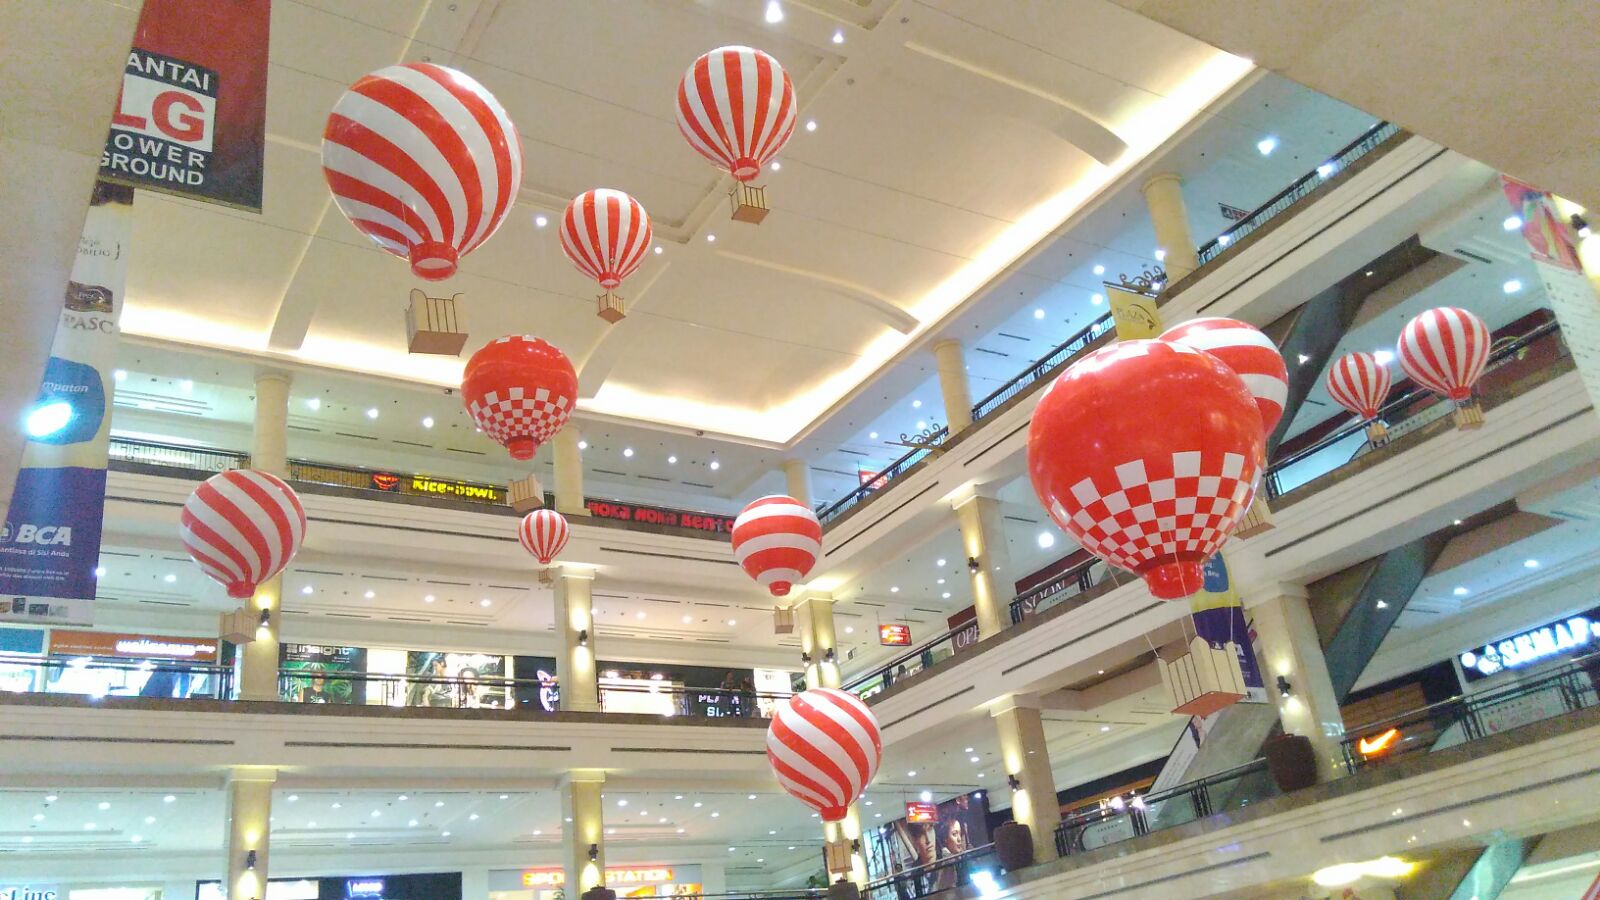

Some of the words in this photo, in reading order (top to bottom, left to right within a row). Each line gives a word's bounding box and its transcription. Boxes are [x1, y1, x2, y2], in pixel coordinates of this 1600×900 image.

[105, 133, 205, 169] OWER
[15, 523, 72, 546] BCA
[298, 644, 355, 657] insight
